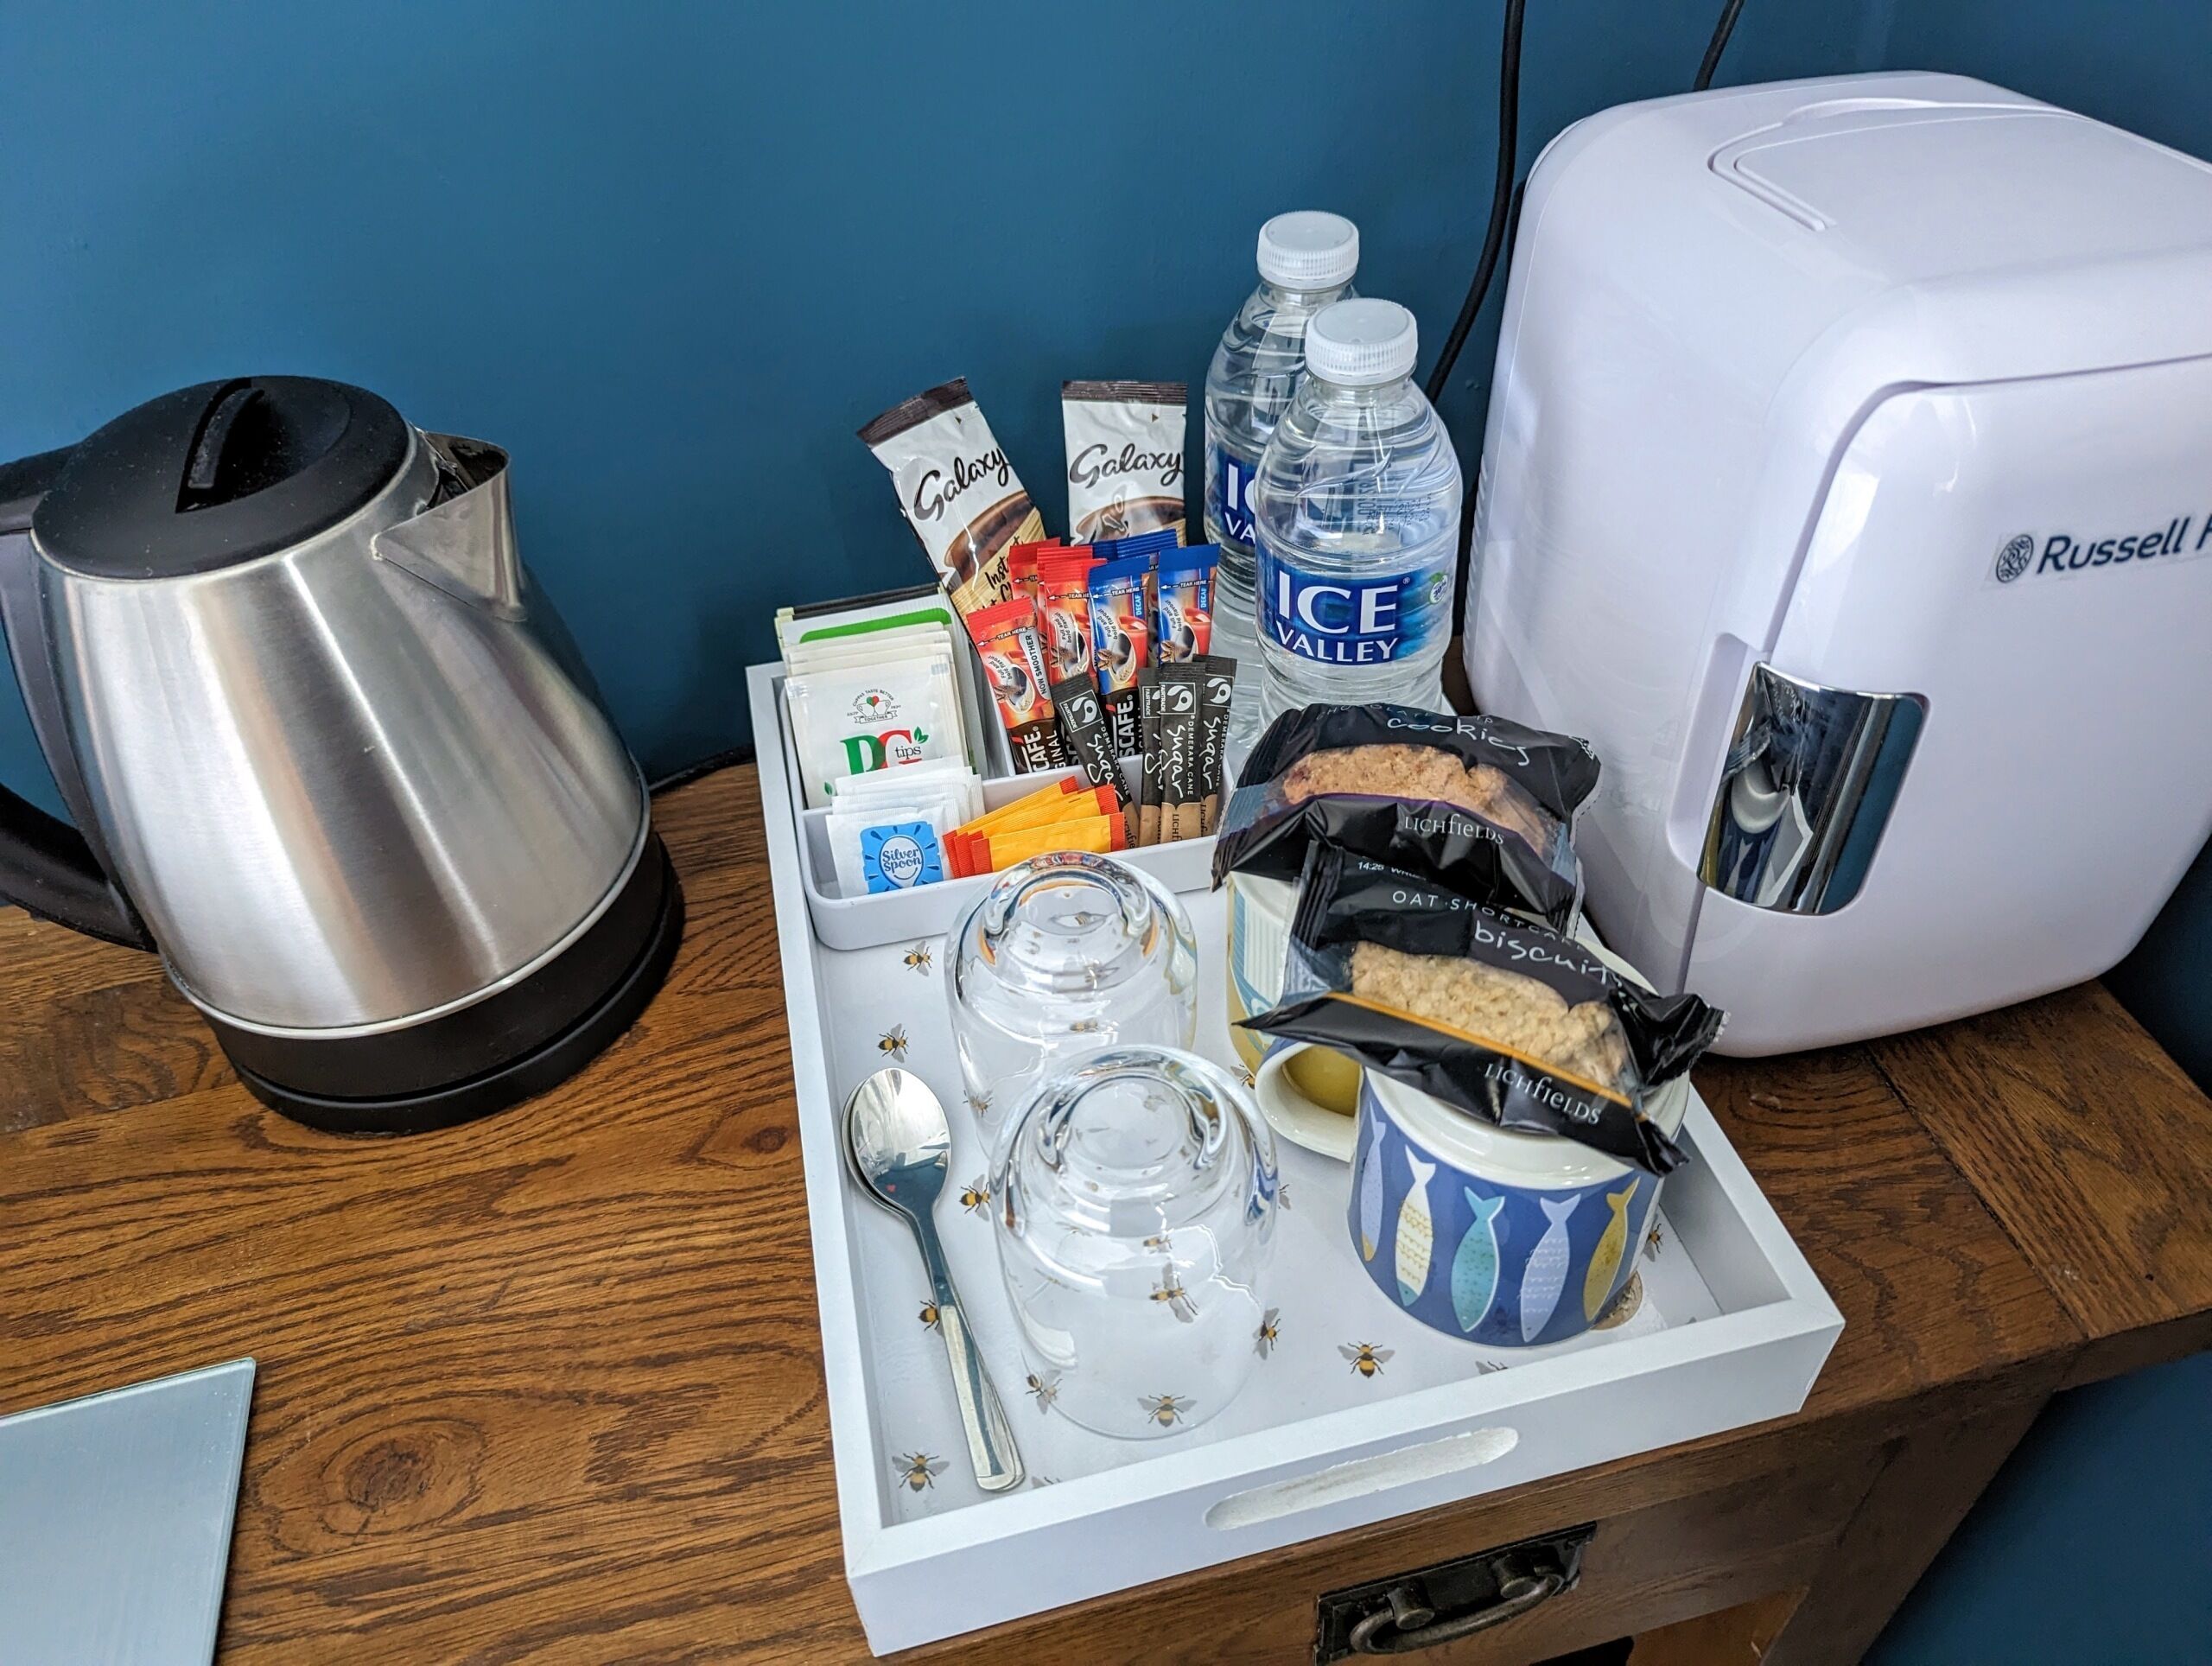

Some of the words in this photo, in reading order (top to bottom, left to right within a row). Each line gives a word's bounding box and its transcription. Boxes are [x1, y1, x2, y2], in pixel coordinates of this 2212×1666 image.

[914, 447, 1012, 521] Galaxy
[1069, 442, 1184, 488] Galaxy
[2037, 516, 2191, 575] Russell
[1278, 570, 1397, 634] ICE
[1025, 634, 1042, 676] SMOOTHER
[1275, 620, 1398, 663] VALLEY
[1037, 677, 1046, 694] NOW
[1063, 703, 1077, 729] FAIRTRADE
[895, 745, 922, 760] tips
[1046, 729, 1066, 769] GINAL
[1160, 724, 1186, 799] Sugar
[1199, 716, 1221, 790] Sugar
[1387, 717, 1530, 766] cookies
[1119, 773, 1129, 796] CANE
[882, 849, 919, 862] Silver
[1393, 891, 1439, 907] OAT
